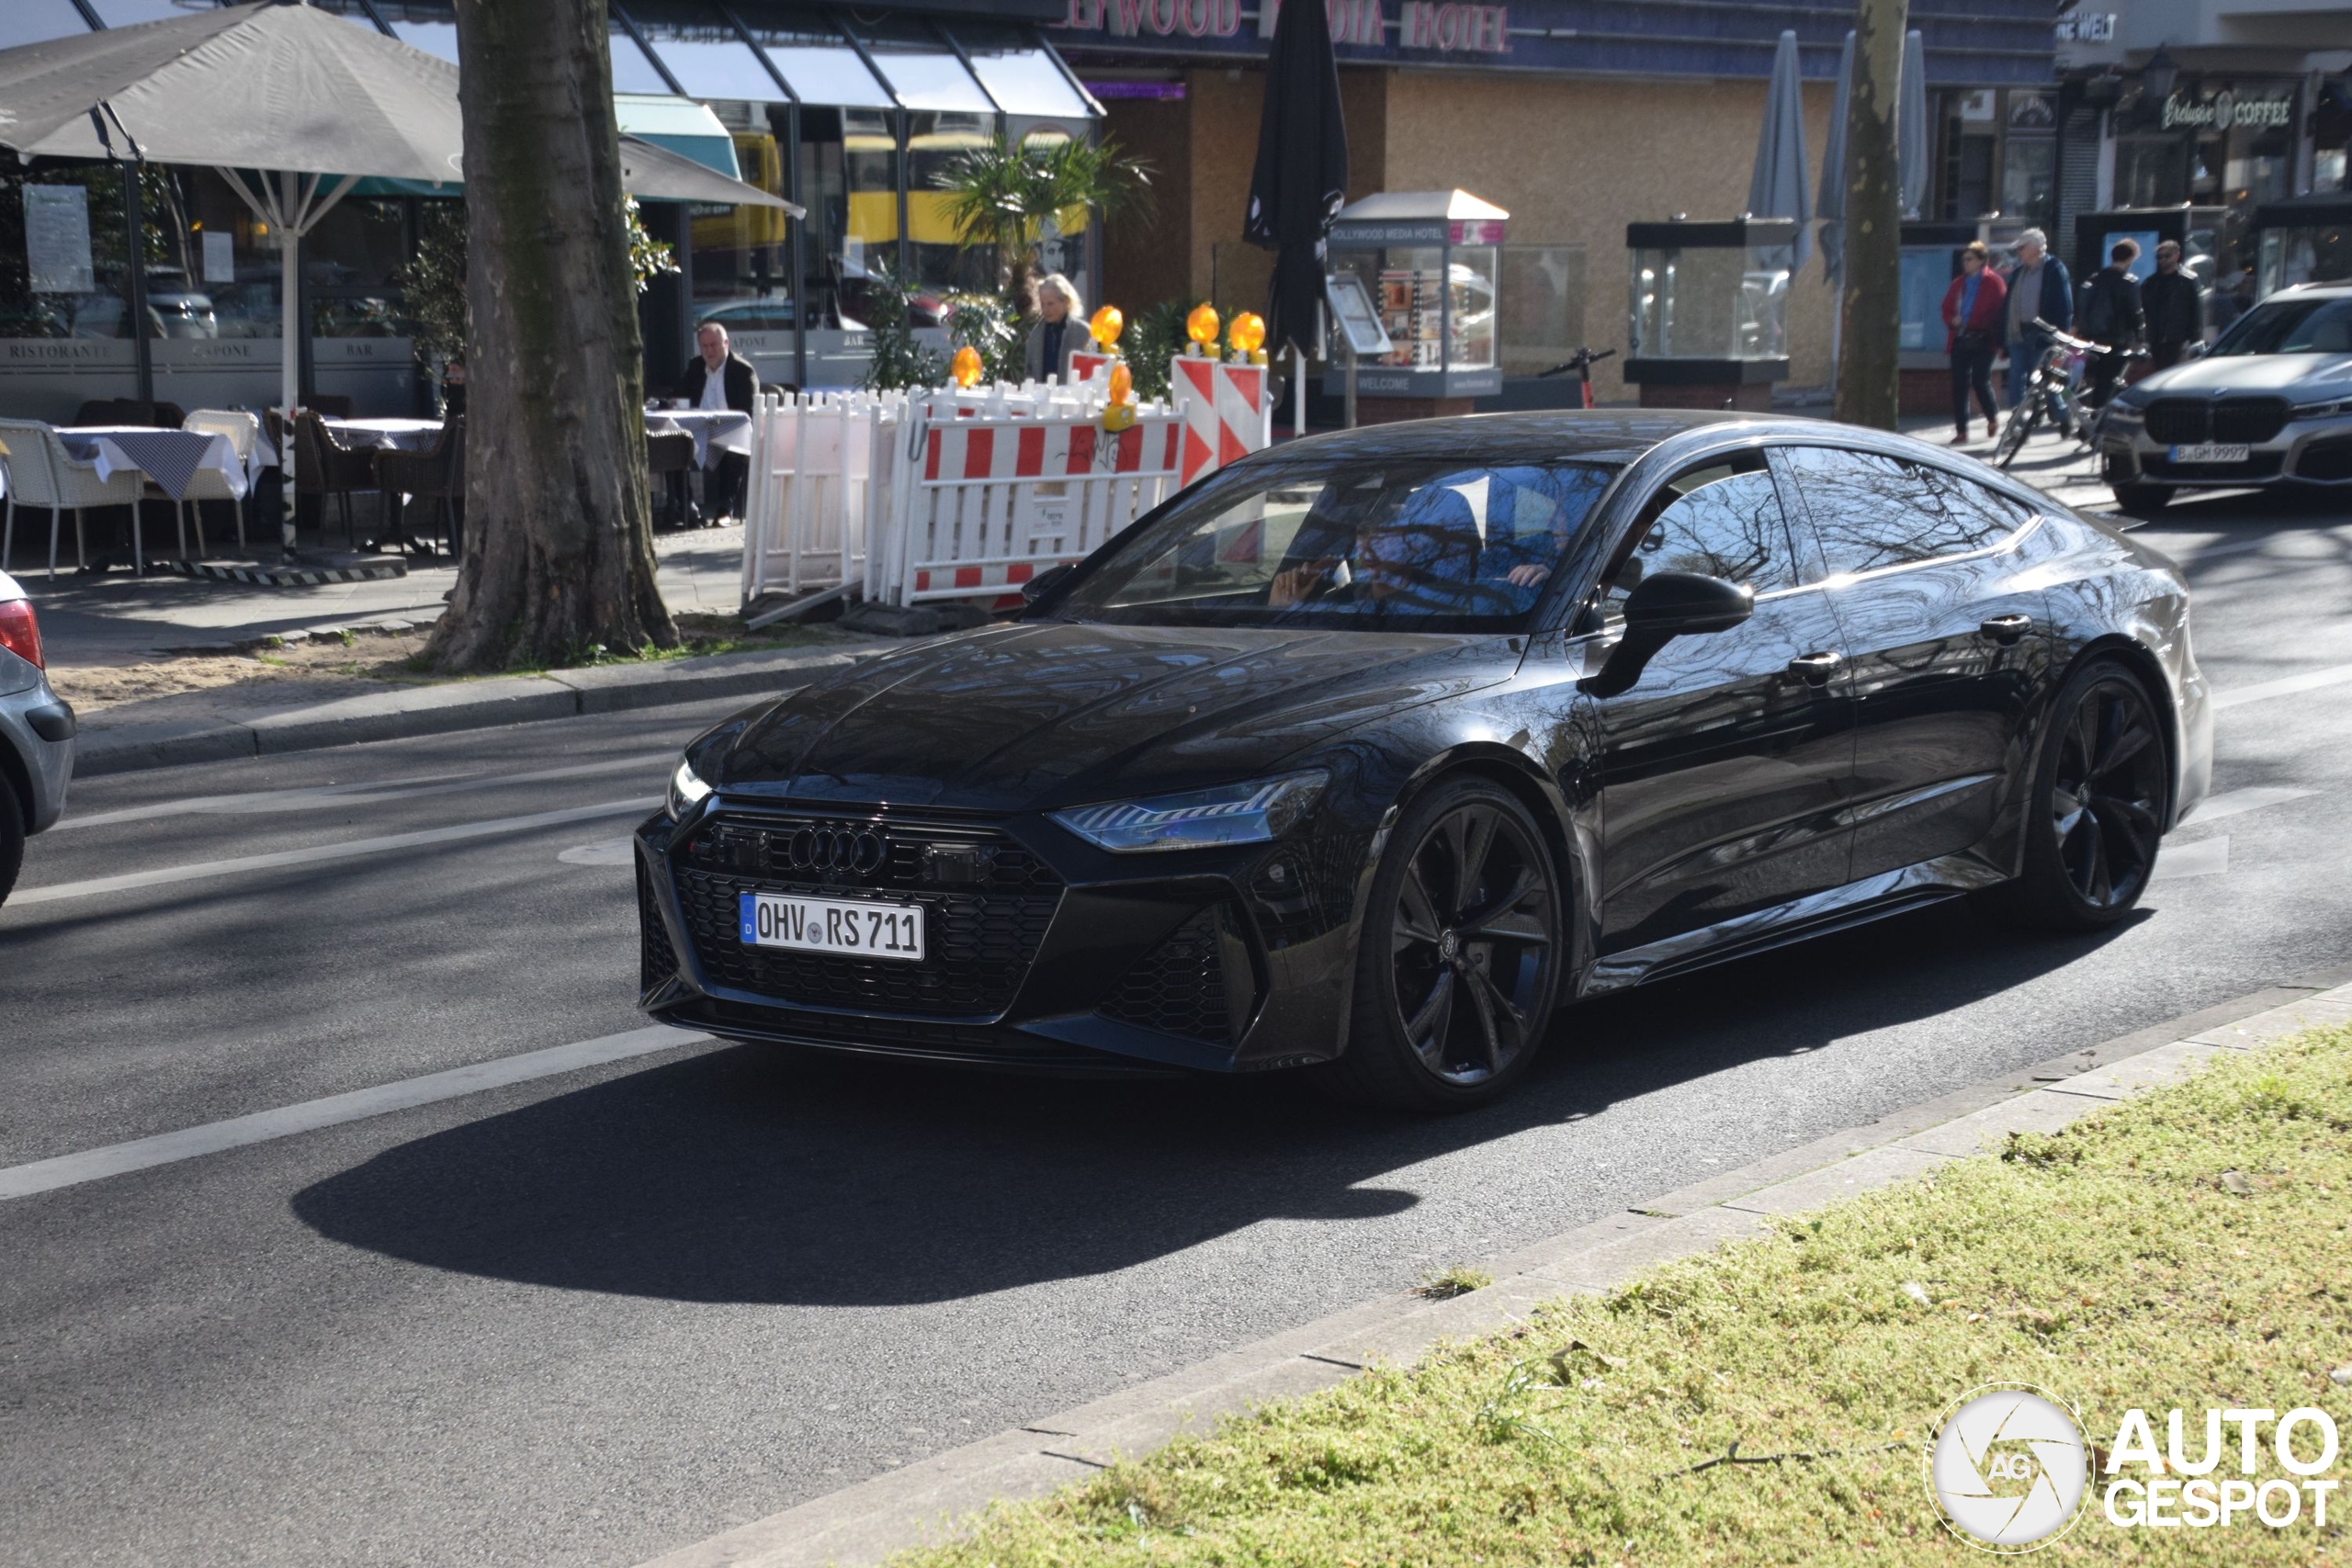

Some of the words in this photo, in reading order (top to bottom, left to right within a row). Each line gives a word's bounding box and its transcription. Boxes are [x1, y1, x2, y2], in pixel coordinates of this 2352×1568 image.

[1411, 1, 1513, 53] HOTEL
[2078, 13, 2117, 40] WELT
[2234, 99, 2291, 126] COFFEE
[1331, 229, 1385, 242] HOLLYWOOD
[1385, 228, 1413, 240] MEDIA
[1414, 227, 1443, 239] HOTEL
[732, 336, 767, 348] APONE
[843, 334, 865, 346] BAR
[9, 344, 112, 359] RISTORANTE
[345, 344, 374, 356] BAR
[1358, 378, 1410, 390] WELCOME
[2177, 446, 2186, 460] B
[2213, 446, 2247, 459] 9997
[745, 923, 752, 934] D
[758, 902, 806, 942] OHV
[826, 908, 860, 946] RS
[867, 910, 918, 952] 711
